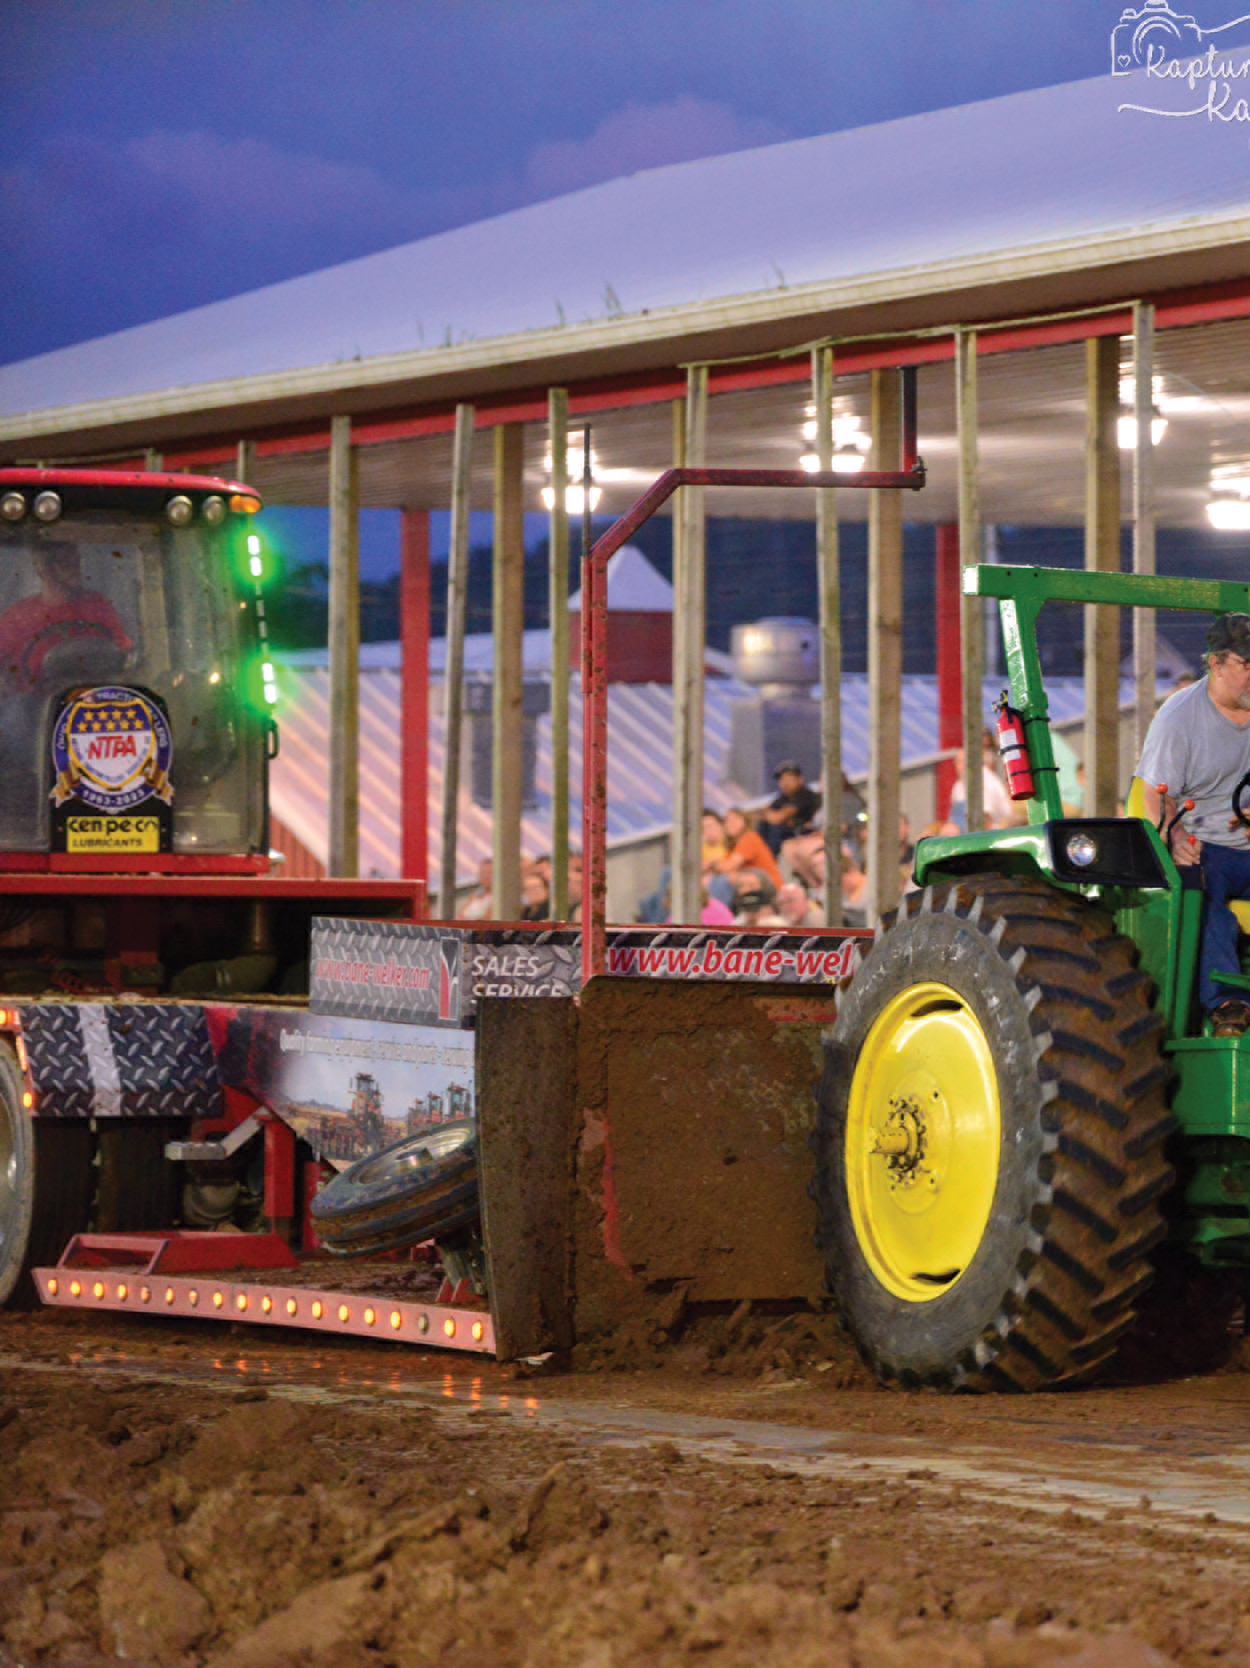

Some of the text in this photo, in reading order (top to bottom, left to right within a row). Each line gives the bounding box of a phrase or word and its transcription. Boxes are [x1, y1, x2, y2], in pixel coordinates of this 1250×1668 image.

[88, 735, 136, 760] NTPA
[72, 838, 143, 848] LUBRICANTS
[471, 955, 539, 977] SALES
[607, 940, 858, 976] www.bane-wel
[315, 953, 431, 989] www.bane-welker.com
